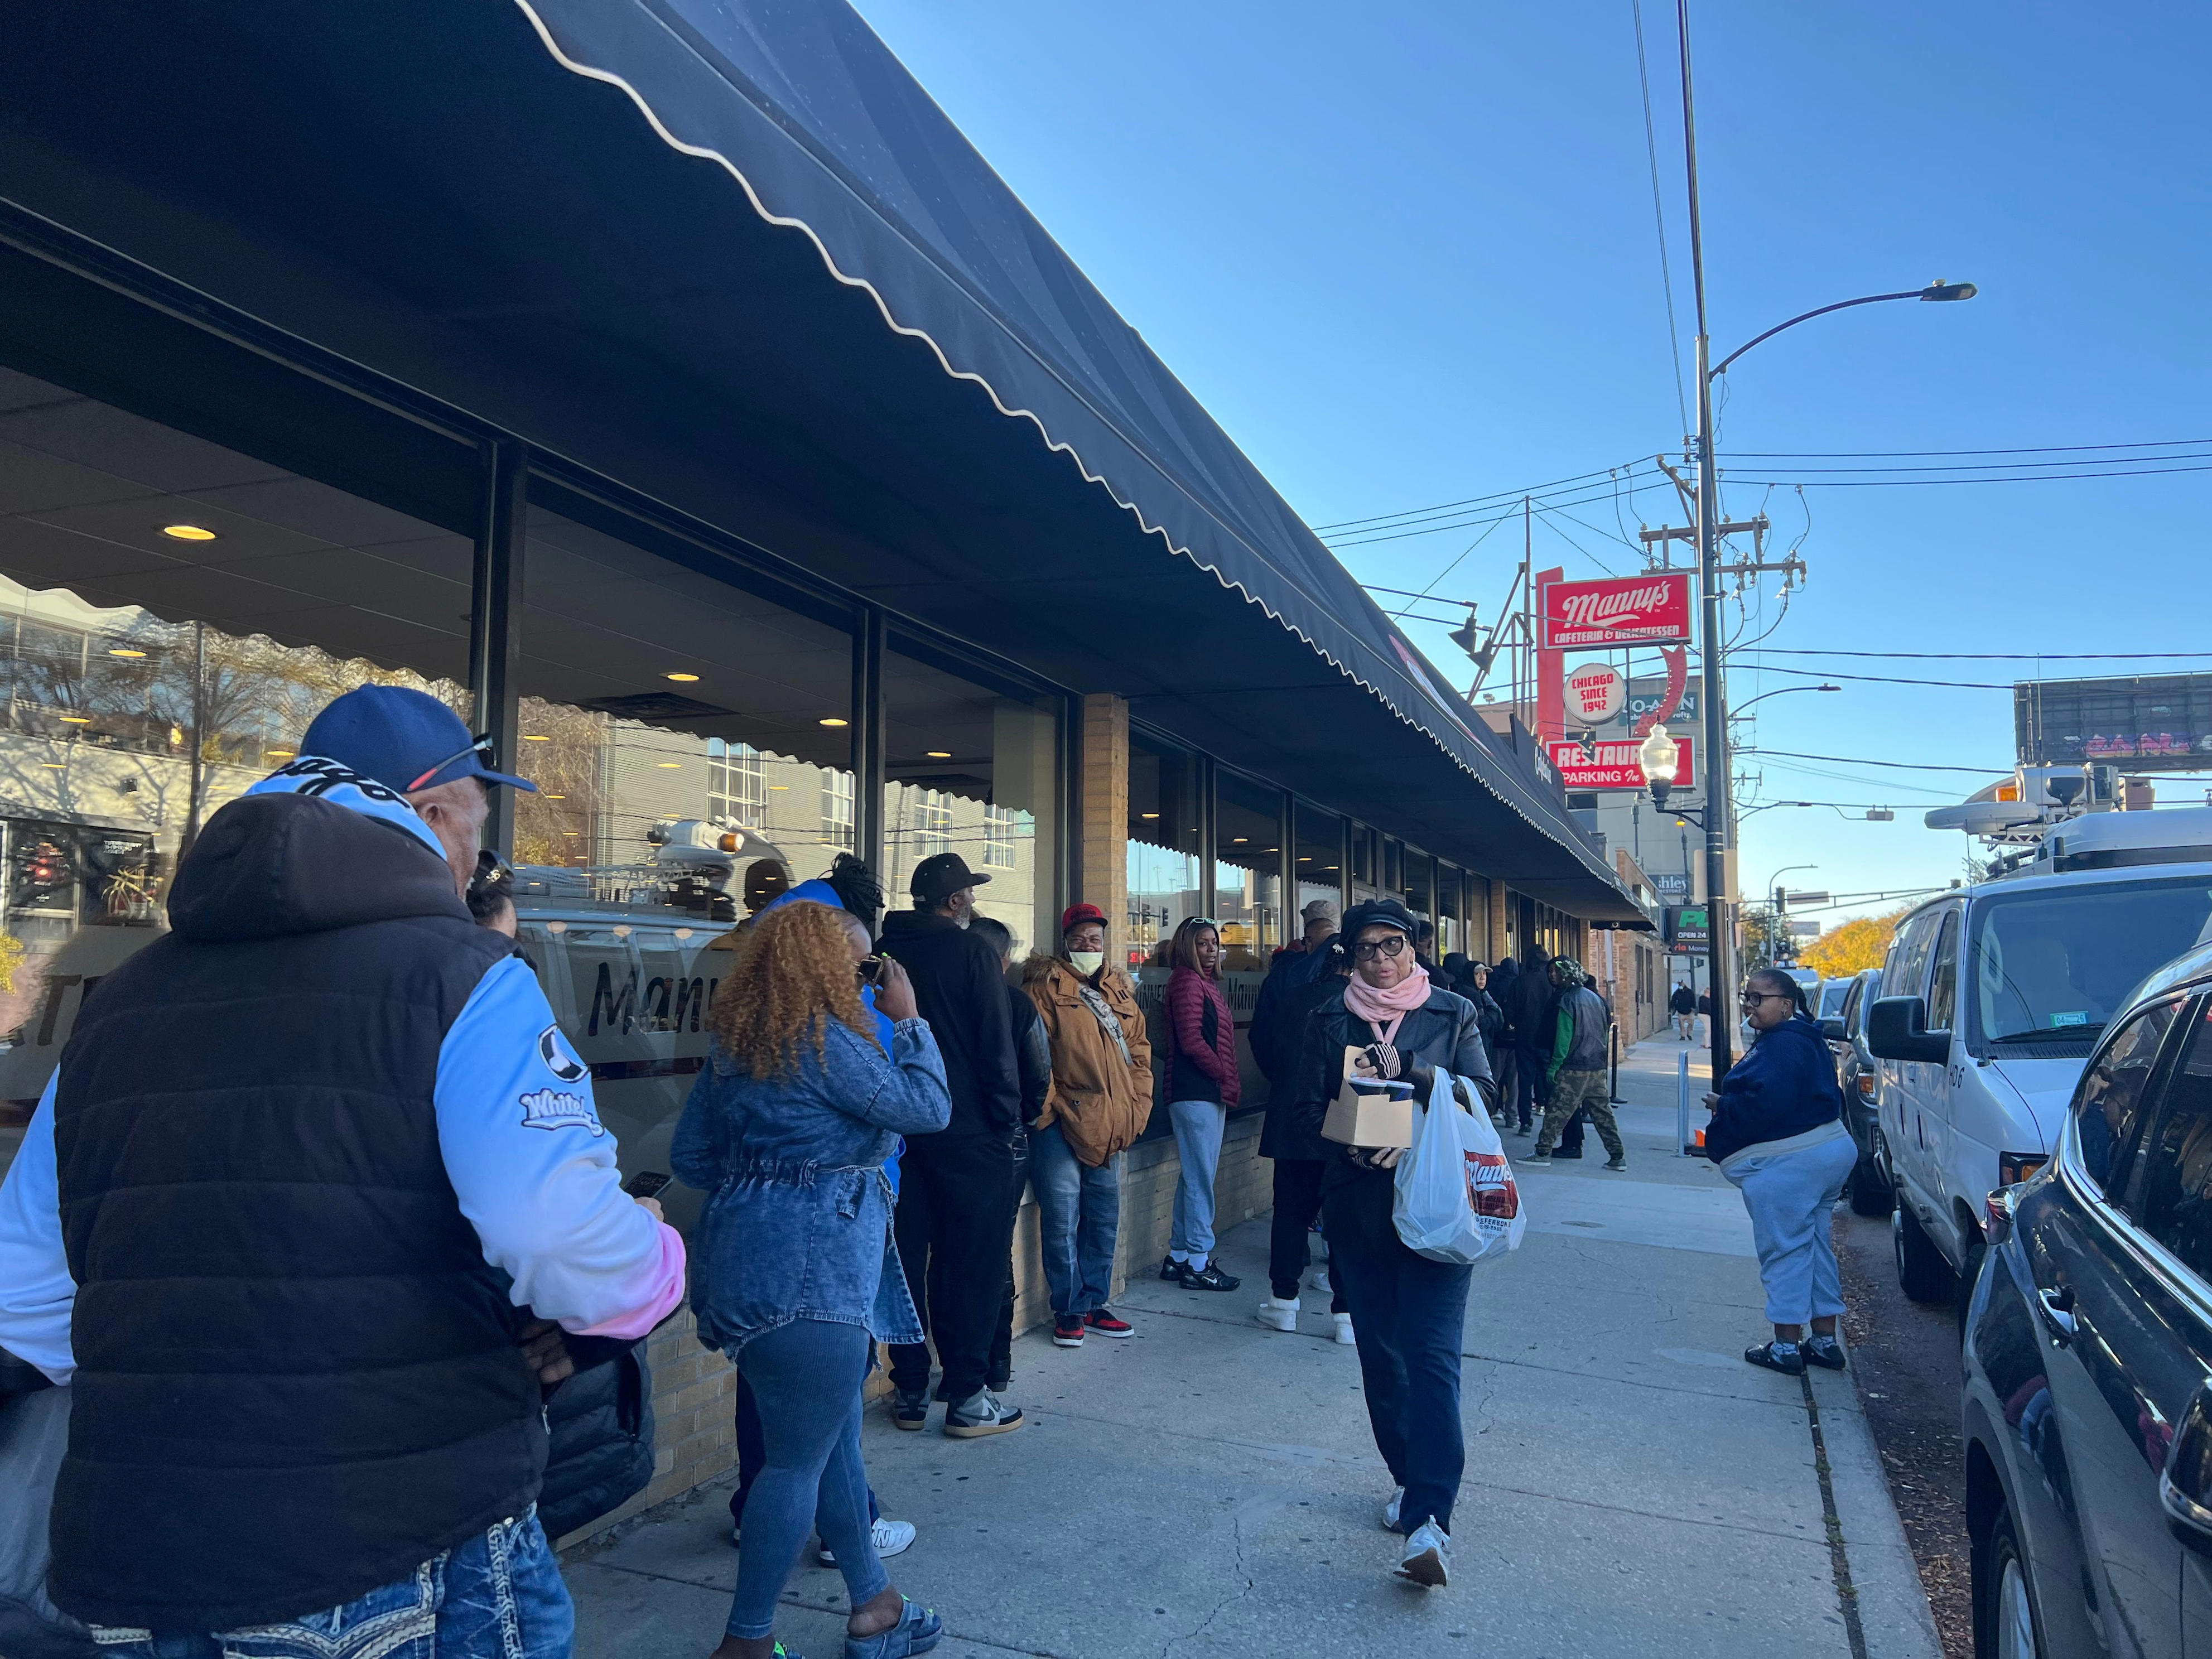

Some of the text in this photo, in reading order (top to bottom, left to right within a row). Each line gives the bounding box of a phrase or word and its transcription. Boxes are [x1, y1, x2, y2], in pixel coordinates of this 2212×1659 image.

[1562, 581, 1671, 628] Manny's
[1555, 630, 1603, 643] CAFETERIA
[1604, 630, 1613, 639] &
[1572, 673, 1614, 689] CHICAGO
[1580, 687, 1607, 701] SINCE
[1583, 700, 1607, 712] 1942
[1557, 743, 1681, 768] RESTAUR
[1562, 770, 1621, 783] PARKING
[1625, 769, 1640, 782] In
[1679, 910, 1709, 928] PL
[2076, 1014, 2085, 1023] 26
[874, 1528, 891, 1548] N
